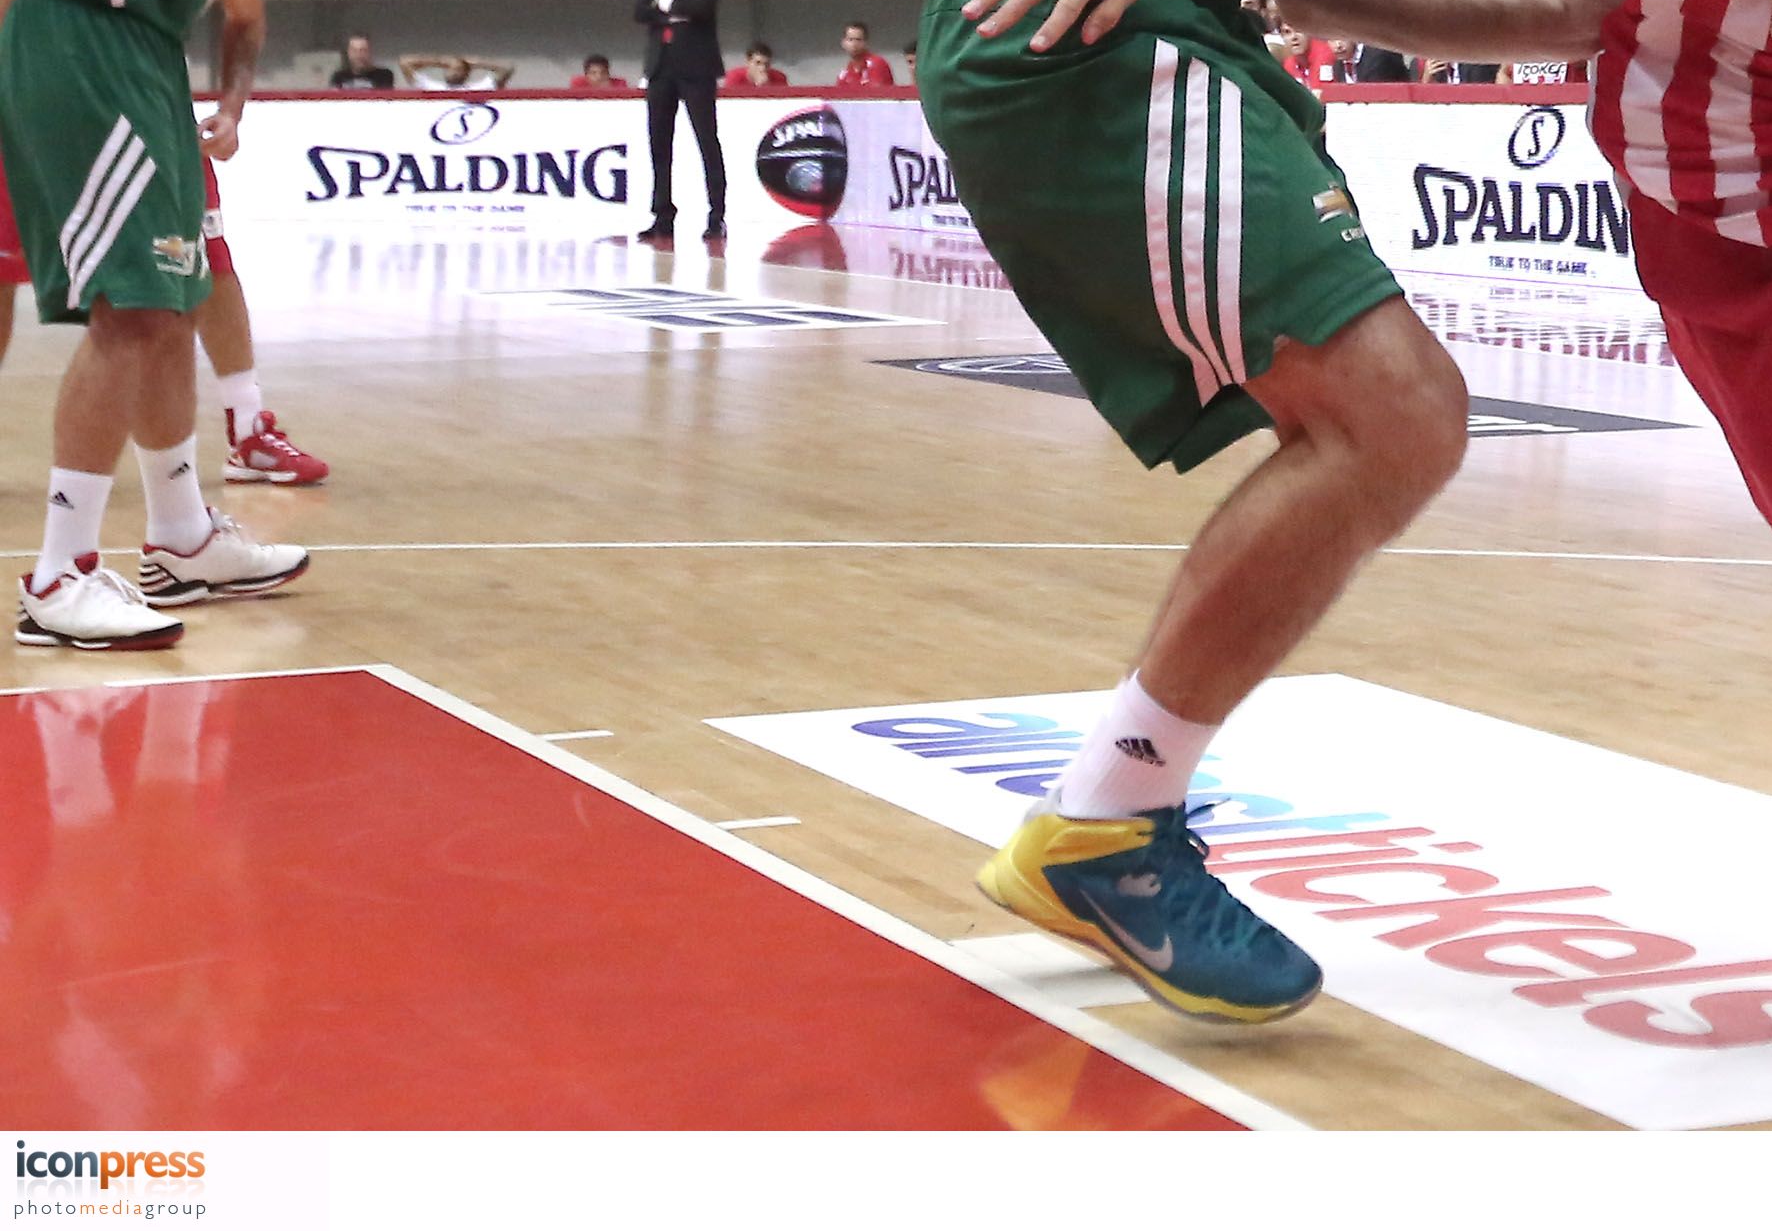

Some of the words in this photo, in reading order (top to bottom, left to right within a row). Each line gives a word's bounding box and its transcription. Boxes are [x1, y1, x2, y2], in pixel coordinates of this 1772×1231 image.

[306, 143, 628, 204] SPALDING
[888, 146, 958, 212] SPAL
[1412, 162, 1630, 257] SPALDIN
